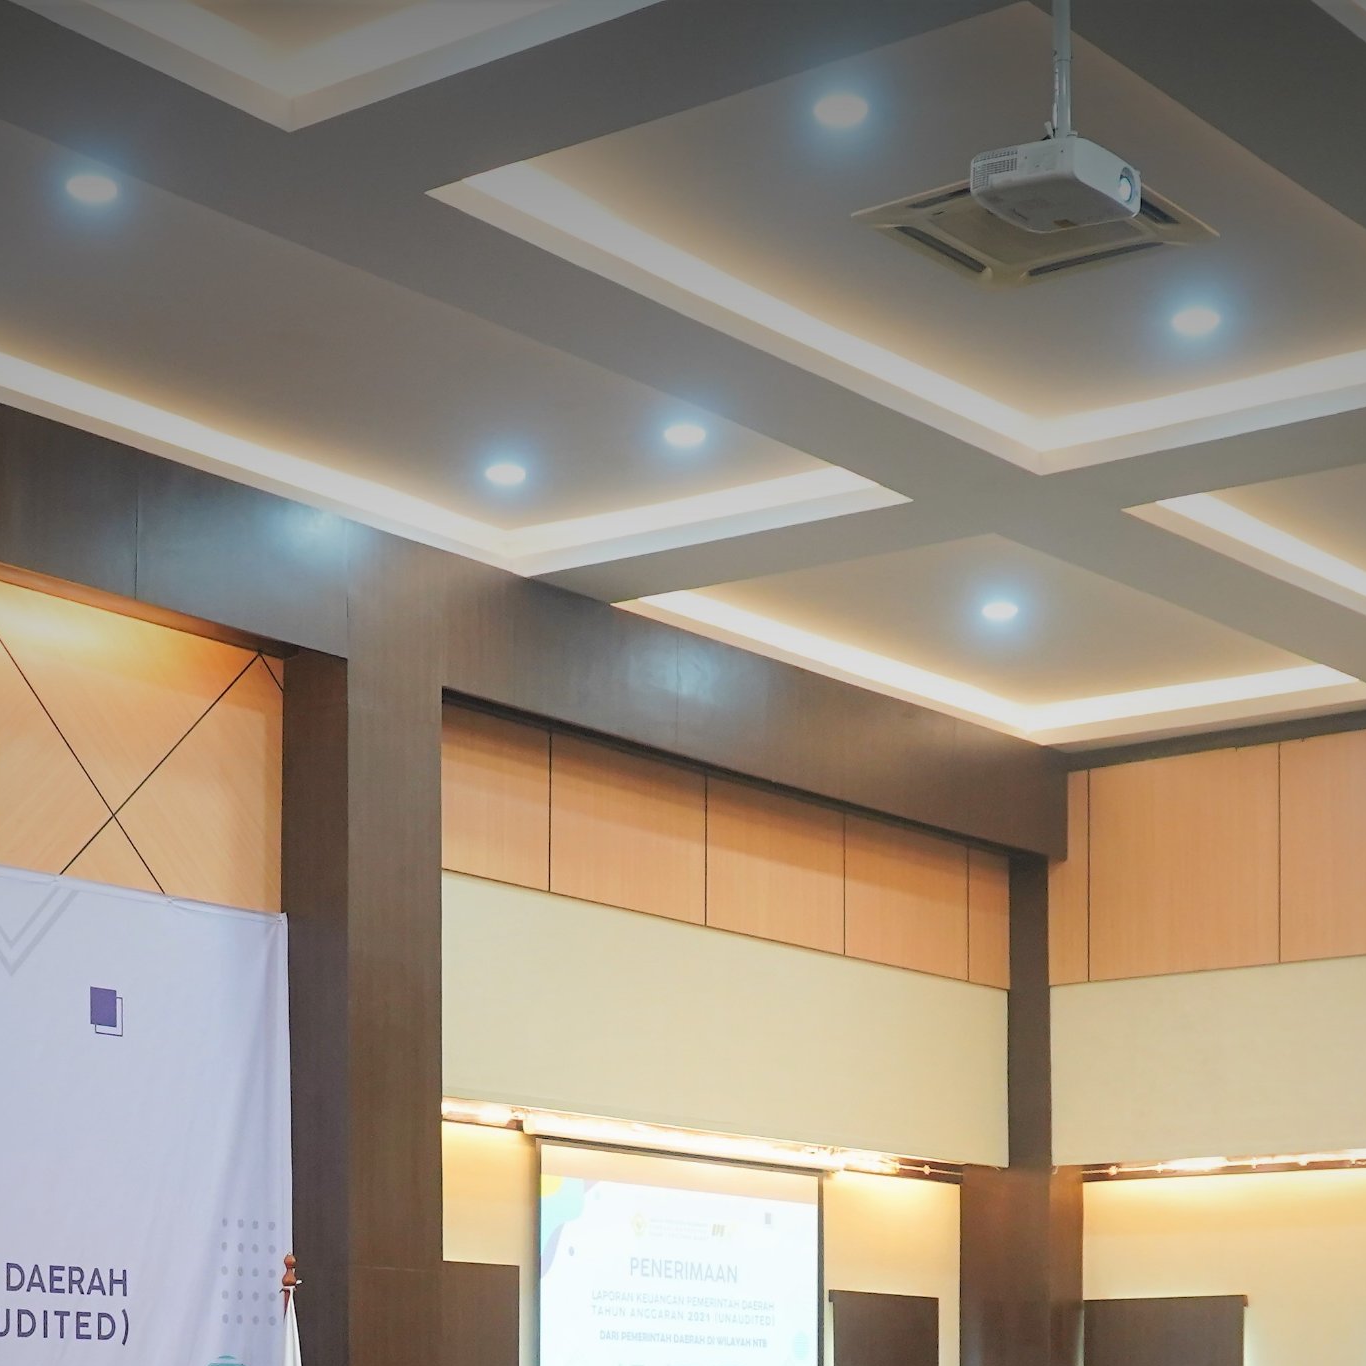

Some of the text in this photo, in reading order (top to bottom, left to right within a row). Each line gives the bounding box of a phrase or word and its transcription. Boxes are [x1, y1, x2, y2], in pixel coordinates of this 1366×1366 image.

[6, 1263, 127, 1297] DAERAH
[630, 1257, 737, 1283] PENERIMAAN
[591, 1305, 626, 1317] TAHUN
[688, 1311, 710, 1322] 2021
[600, 1330, 619, 1340] DARI
